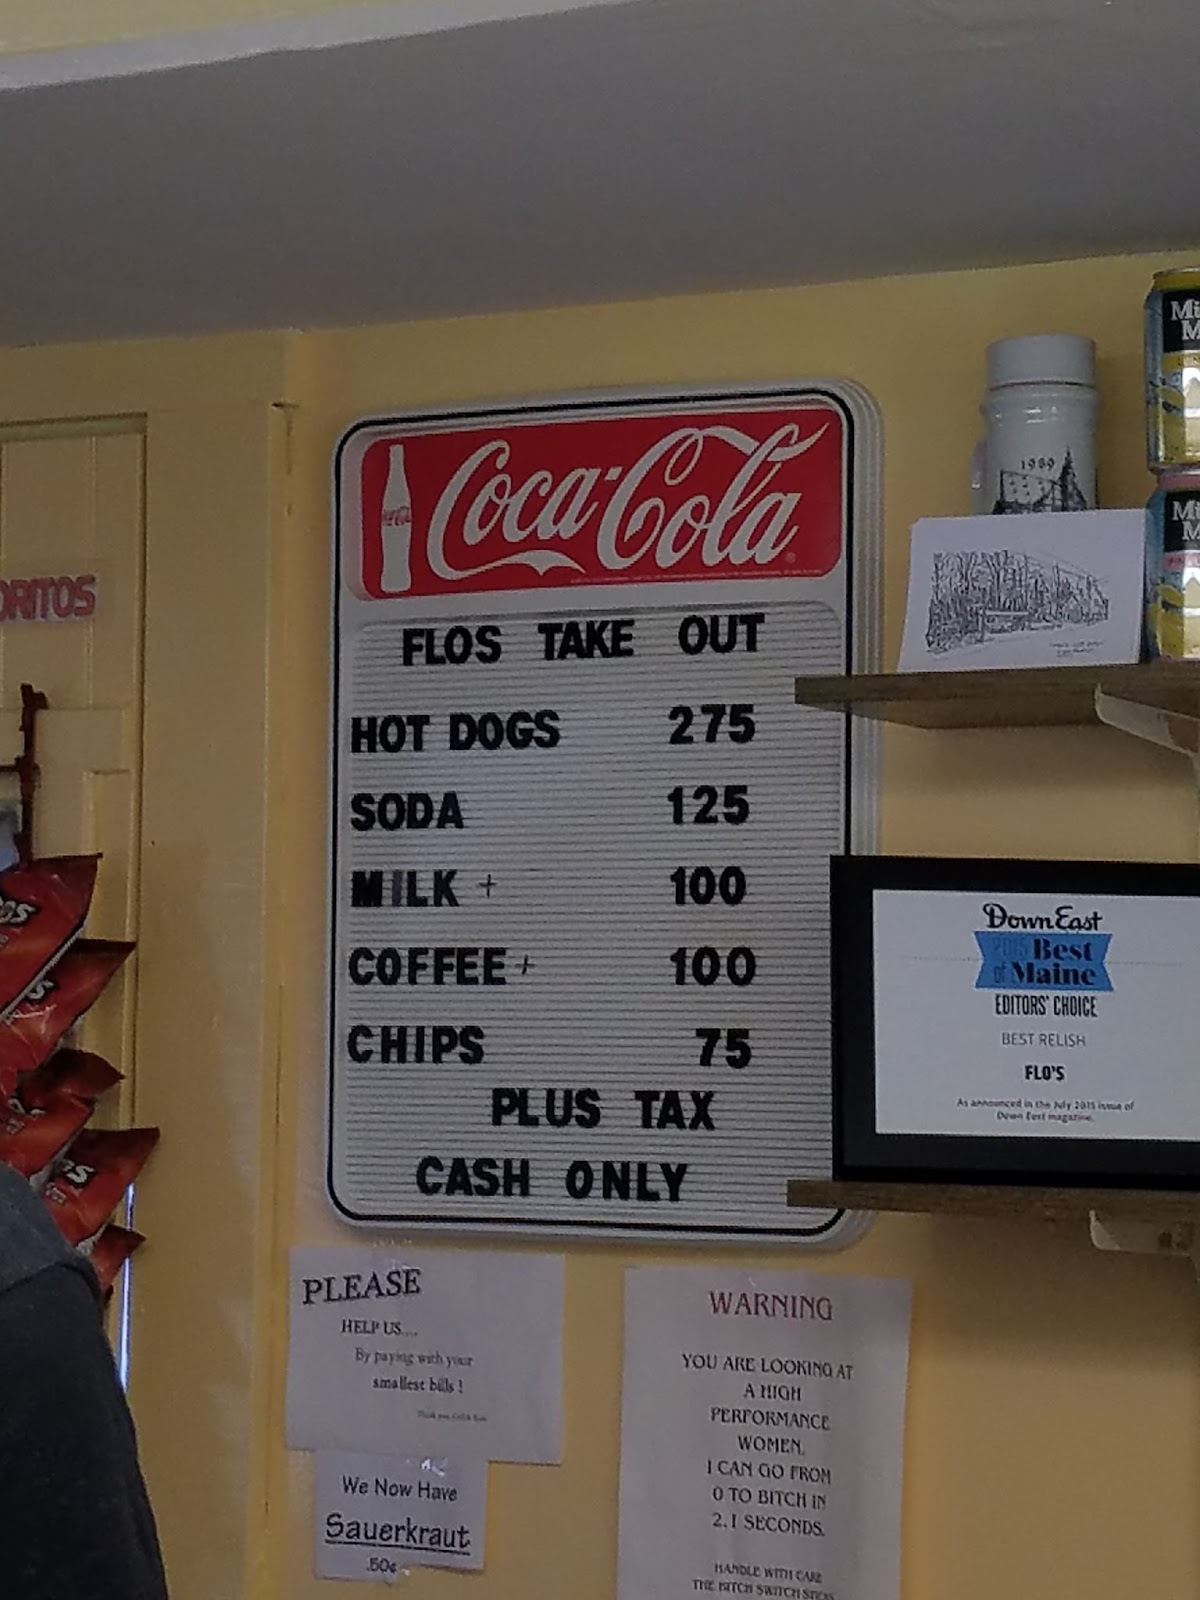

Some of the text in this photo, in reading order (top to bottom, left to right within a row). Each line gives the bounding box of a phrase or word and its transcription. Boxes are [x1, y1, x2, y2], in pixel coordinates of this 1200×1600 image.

[427, 421, 830, 581] Coca-Cola
[402, 613, 765, 666] FLOS TAKE OUT
[351, 705, 755, 753] HOT DOGS 275
[351, 785, 750, 831] SODA 125
[351, 869, 460, 907] MILK
[670, 866, 746, 905] 100
[1034, 937, 1093, 961] Best
[348, 947, 507, 986] COFFEE
[670, 946, 756, 987] 100
[1012, 961, 1097, 986] Maine
[995, 994, 1098, 1018] EDITORS' CHOICE
[347, 1024, 752, 1069] CHIPS 75
[1002, 1033, 1086, 1047] BEST RELISH
[1025, 1065, 1065, 1081] FLO'S
[492, 1087, 716, 1130] PLUS TAX
[416, 1155, 688, 1202] CASH ONLY
[303, 1268, 422, 1305] PLEASE
[709, 1290, 833, 1321] WARNING
[341, 1319, 380, 1334] HELP
[355, 1347, 474, 1368] By paying with your
[682, 1353, 853, 1380] YOU ARE LOOKING AT
[373, 1375, 425, 1392] smallest
[744, 1383, 802, 1402] A HIGH
[711, 1407, 831, 1430] PERFORMANCE
[707, 1460, 831, 1484] I CAN GO FROM
[342, 1475, 457, 1501] We Now Have
[728, 1487, 751, 1503] TO
[758, 1490, 807, 1508] BITCH
[812, 1494, 826, 1509] IN
[325, 1512, 471, 1550] Sauerkraut
[715, 1562, 822, 1583] HANDLE WITH CARE
